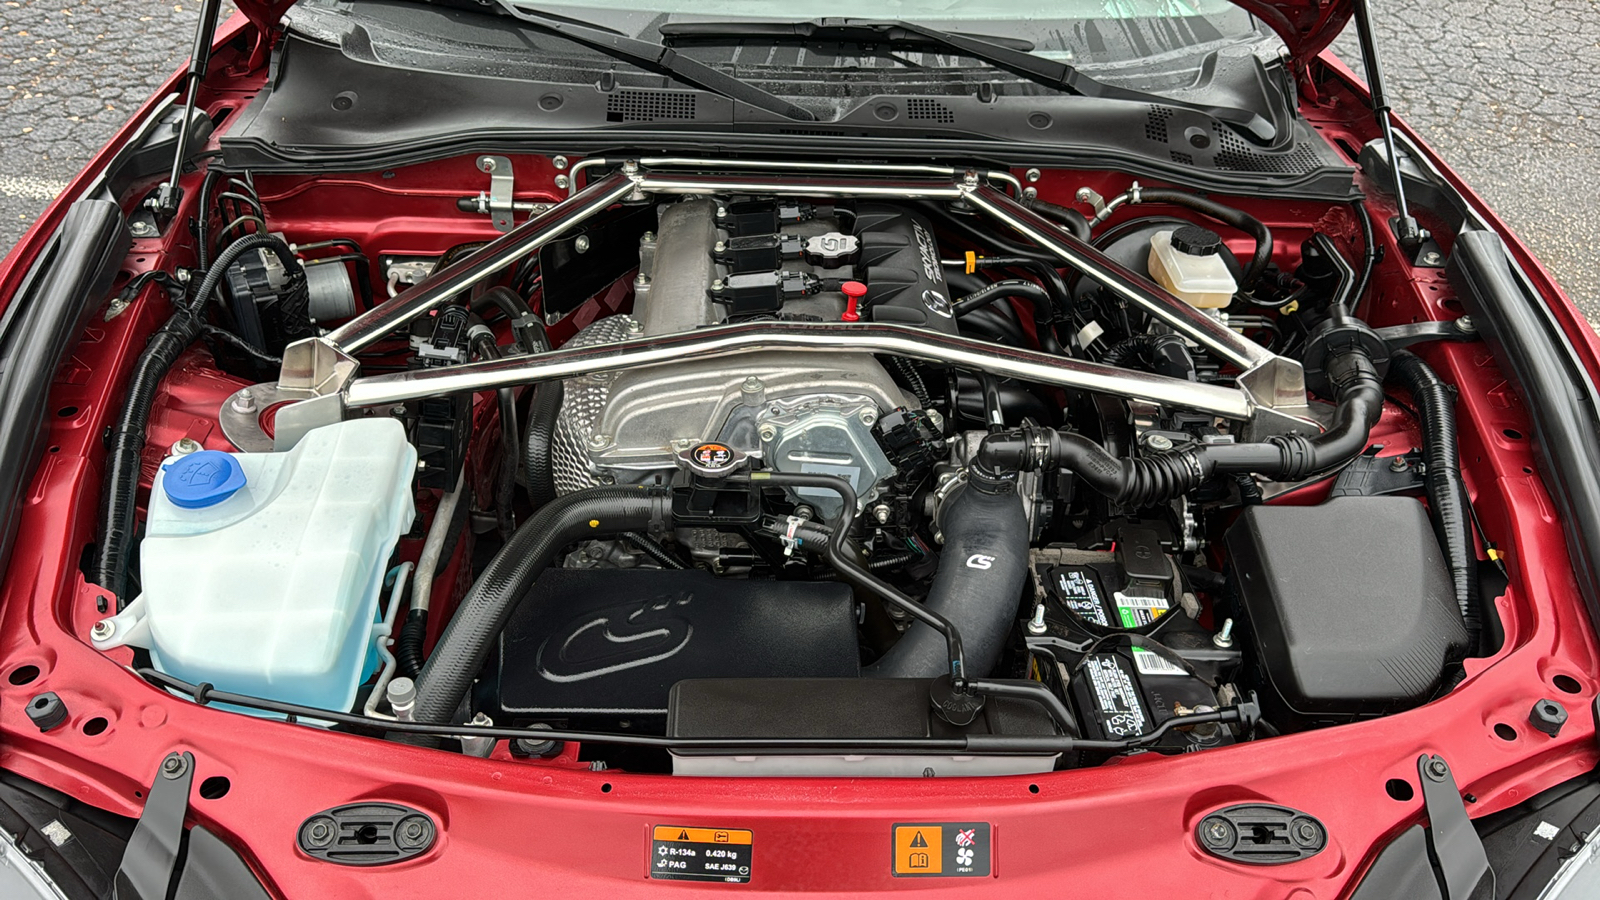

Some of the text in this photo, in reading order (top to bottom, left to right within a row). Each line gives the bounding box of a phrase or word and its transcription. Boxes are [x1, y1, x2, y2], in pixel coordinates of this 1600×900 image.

[911, 218, 937, 284] SKYACTIV
[942, 699, 975, 715] COOLANT
[669, 847, 737, 860] R-134a 0.420 kg
[669, 861, 736, 871] PAG SAE J639
